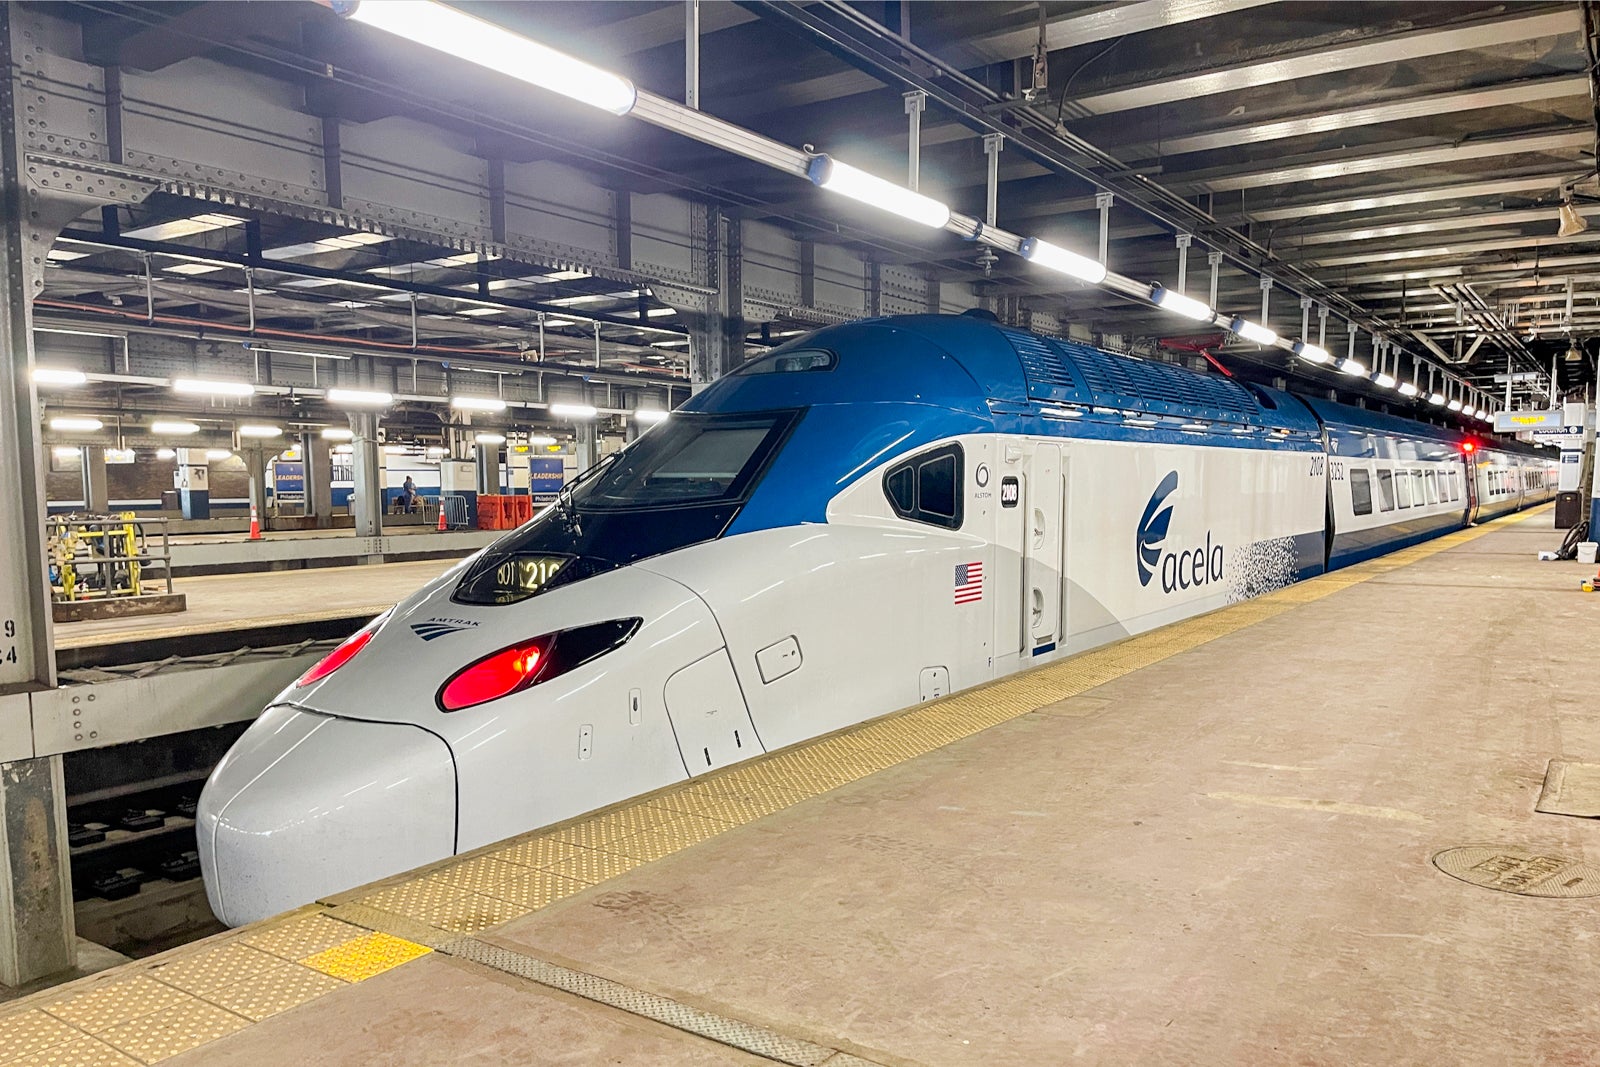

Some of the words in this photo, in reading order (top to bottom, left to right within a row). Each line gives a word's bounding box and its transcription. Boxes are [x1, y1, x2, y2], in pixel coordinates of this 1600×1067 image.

[1310, 456, 1324, 476] 2108
[1330, 462, 1344, 480] 3252
[1002, 484, 1018, 501] 2108
[1162, 529, 1223, 594] acela
[426, 617, 480, 626] AMTRAK
